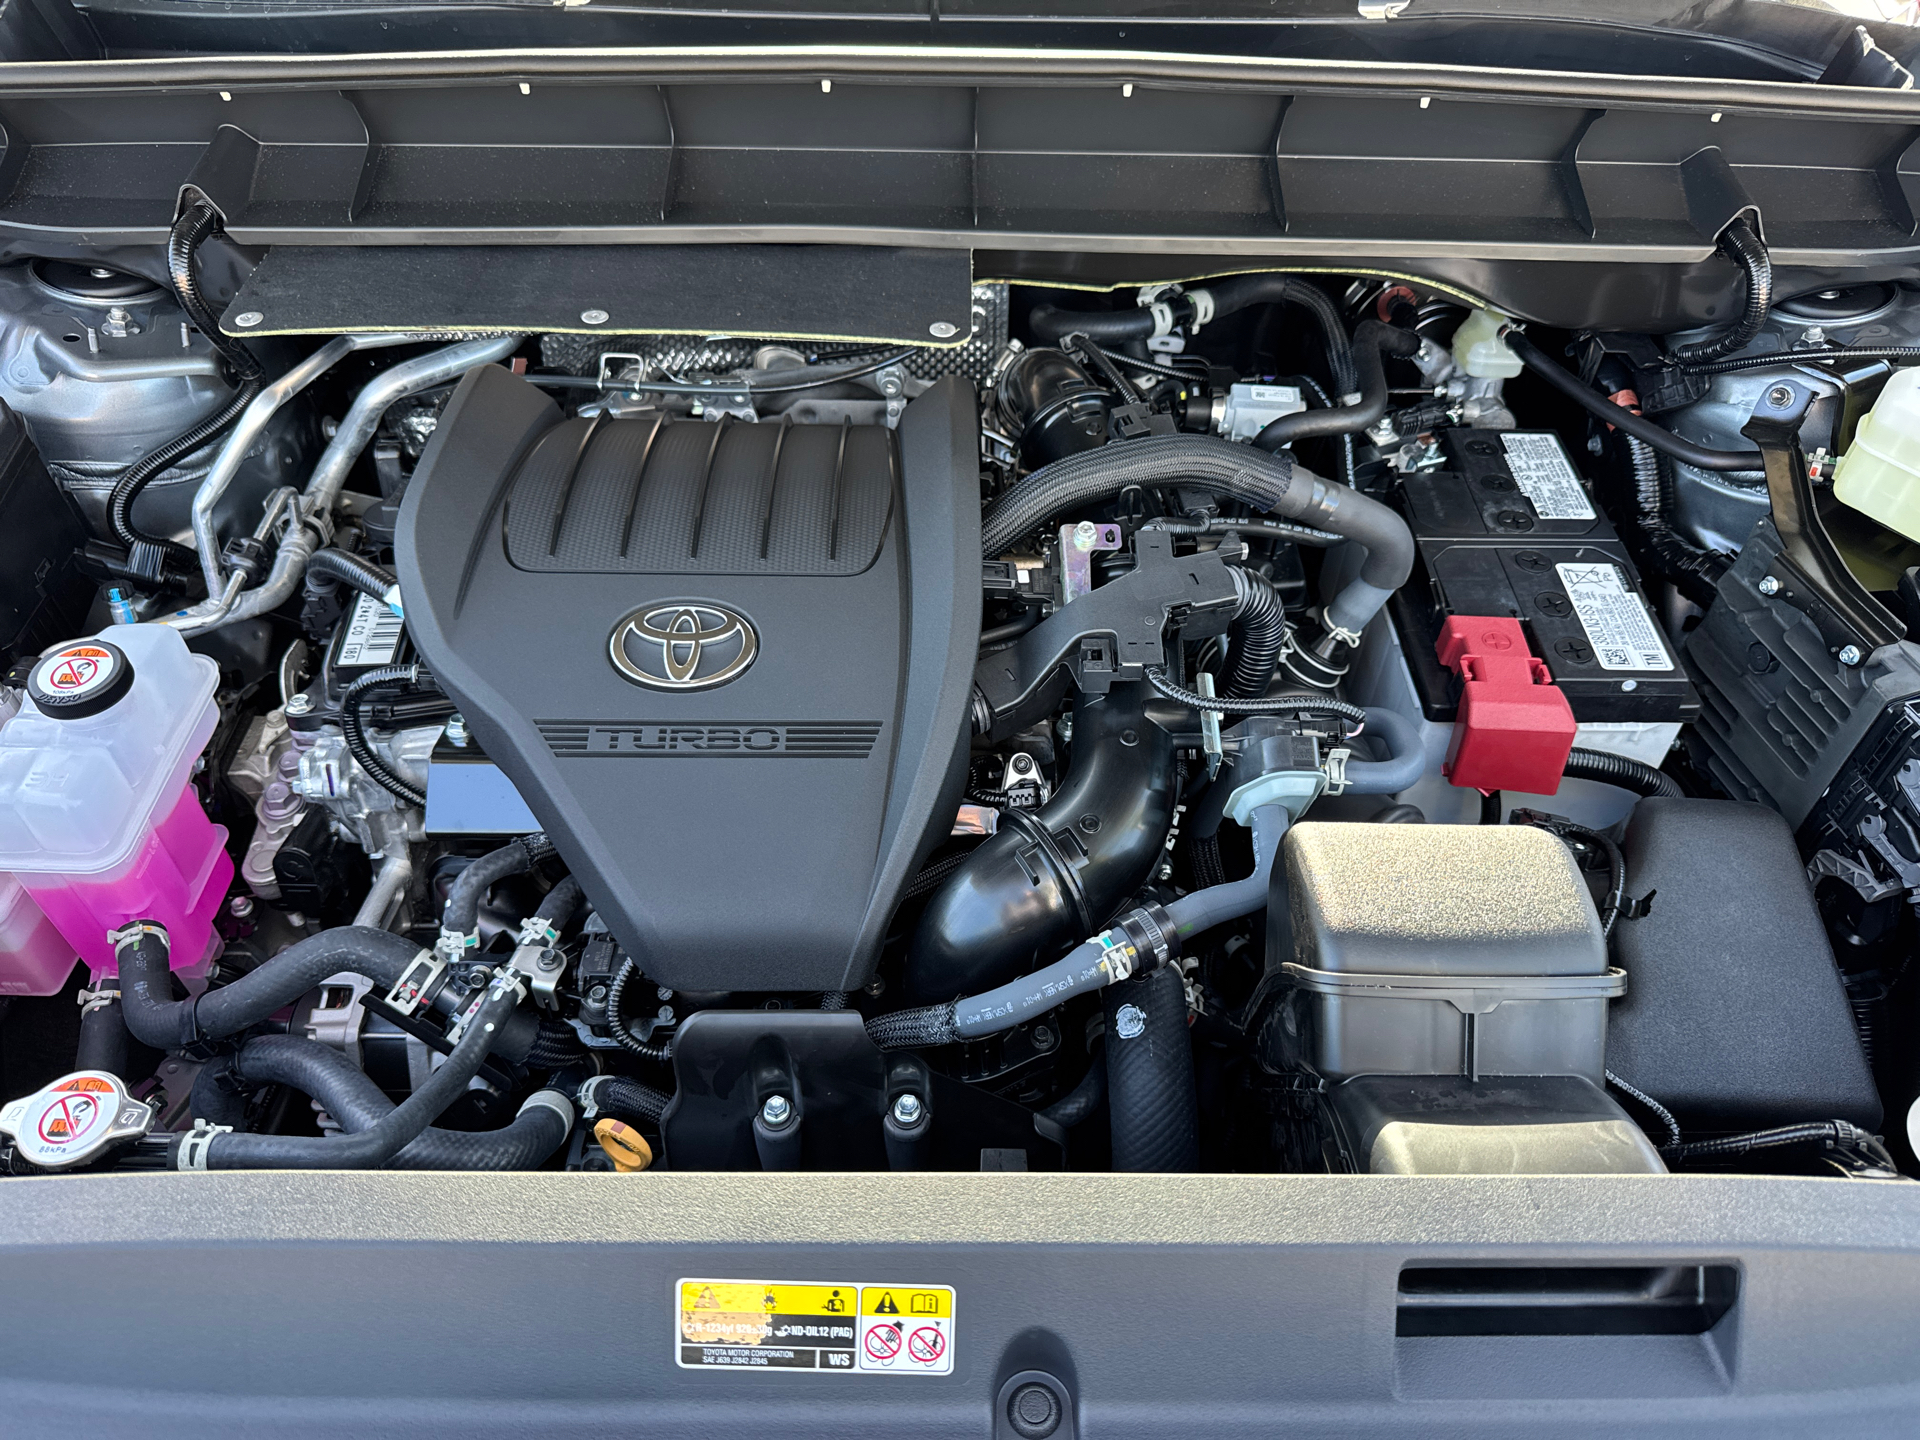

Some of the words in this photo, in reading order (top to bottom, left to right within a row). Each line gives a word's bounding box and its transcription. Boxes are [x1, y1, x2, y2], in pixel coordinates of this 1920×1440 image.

[37, 694, 81, 704] DENSO
[595, 727, 780, 750] TURBO
[830, 1327, 853, 1339] (PAG)
[703, 1348, 727, 1356] TOYOTA
[728, 1348, 750, 1357] MOTOR
[751, 1349, 794, 1359] CORPORATION
[703, 1356, 715, 1364] SAE
[716, 1356, 731, 1364] J639
[828, 1353, 850, 1366] WS
